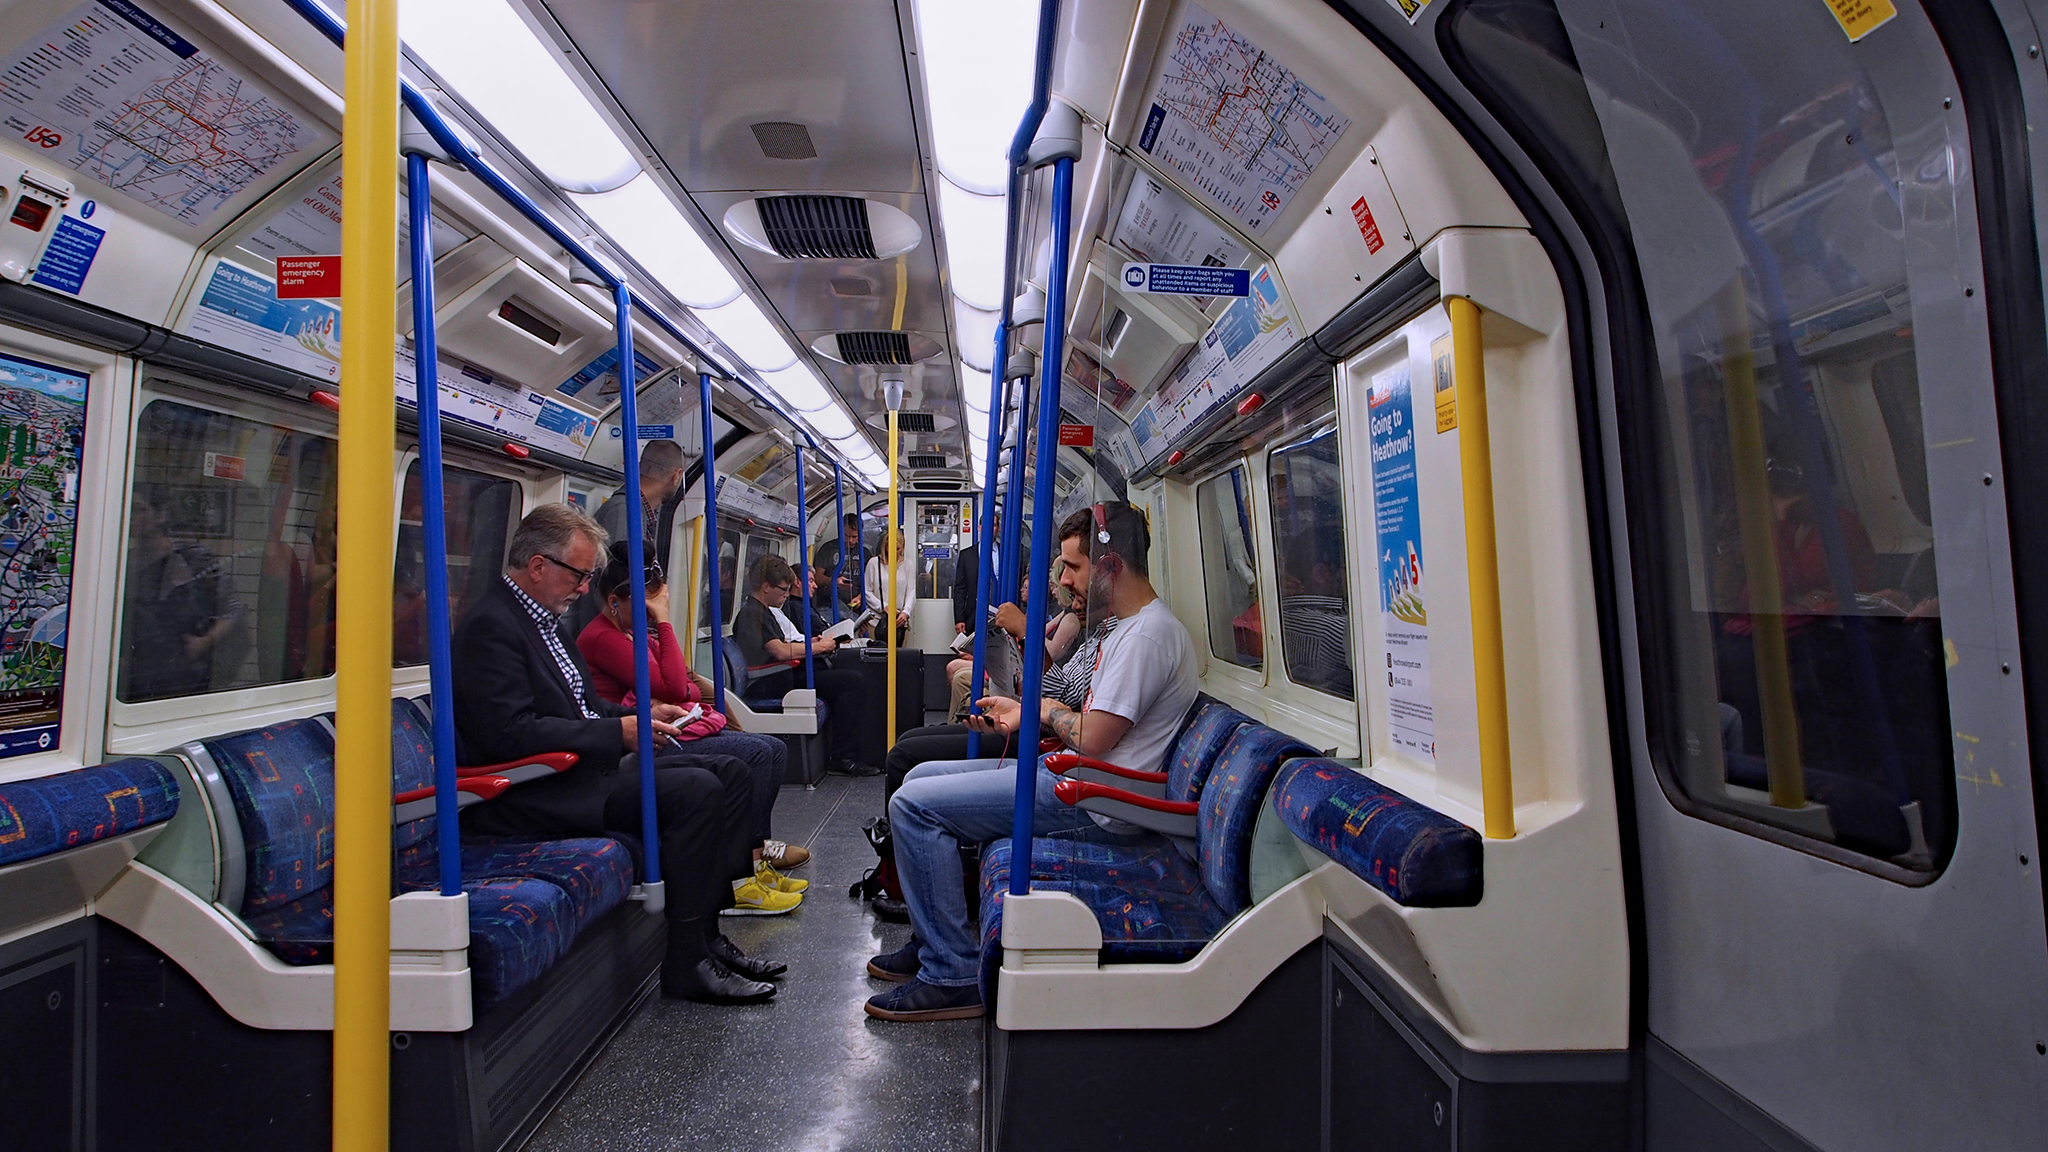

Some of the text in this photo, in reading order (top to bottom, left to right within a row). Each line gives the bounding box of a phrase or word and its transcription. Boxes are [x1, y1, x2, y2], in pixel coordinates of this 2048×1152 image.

[128, 11, 151, 28] London
[150, 25, 165, 37] Tube
[302, 197, 317, 206] of
[312, 201, 331, 214] Old
[71, 224, 101, 240] emergency
[281, 260, 321, 269] Passenger
[216, 265, 272, 293] Going to Heathrow?
[282, 269, 325, 278] emergency
[282, 277, 305, 285] alarm
[307, 323, 313, 334] 3
[315, 320, 322, 334] 4
[324, 318, 333, 335] 5
[1371, 409, 1402, 437] Going to
[1372, 428, 1412, 463] Heathrow?
[1396, 577, 1400, 594] 3
[1402, 565, 1408, 590] 4
[1411, 554, 1418, 585] 5
